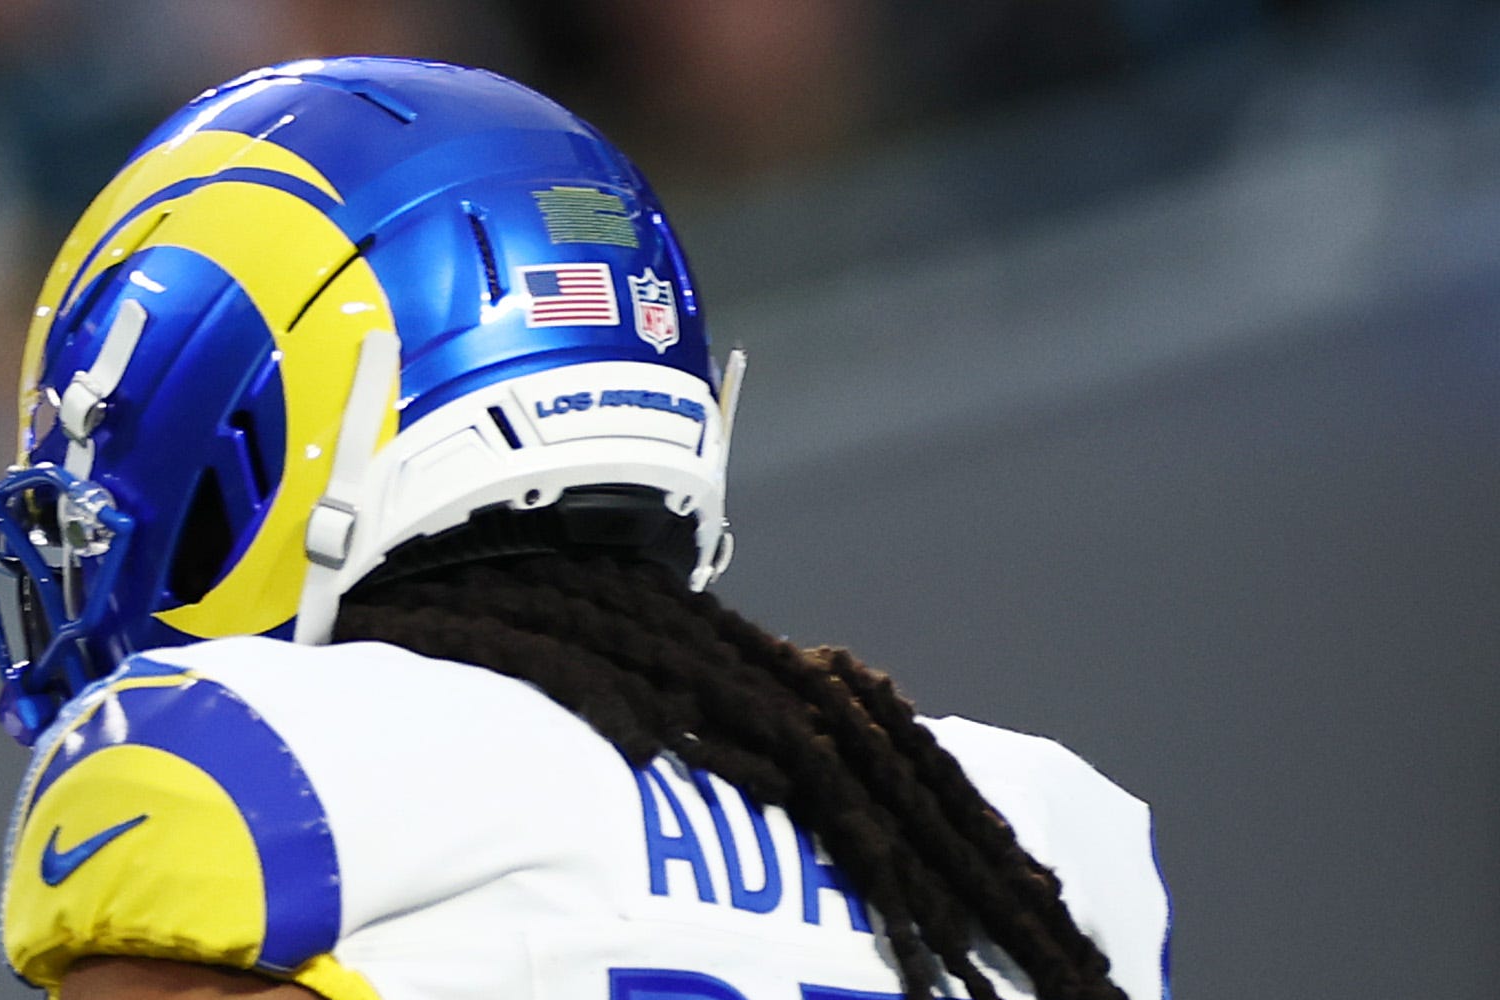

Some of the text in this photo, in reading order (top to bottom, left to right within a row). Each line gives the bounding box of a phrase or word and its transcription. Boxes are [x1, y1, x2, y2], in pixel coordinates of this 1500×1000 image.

[535, 389, 706, 423] LOS ANGELES
[635, 764, 874, 934] ADA
